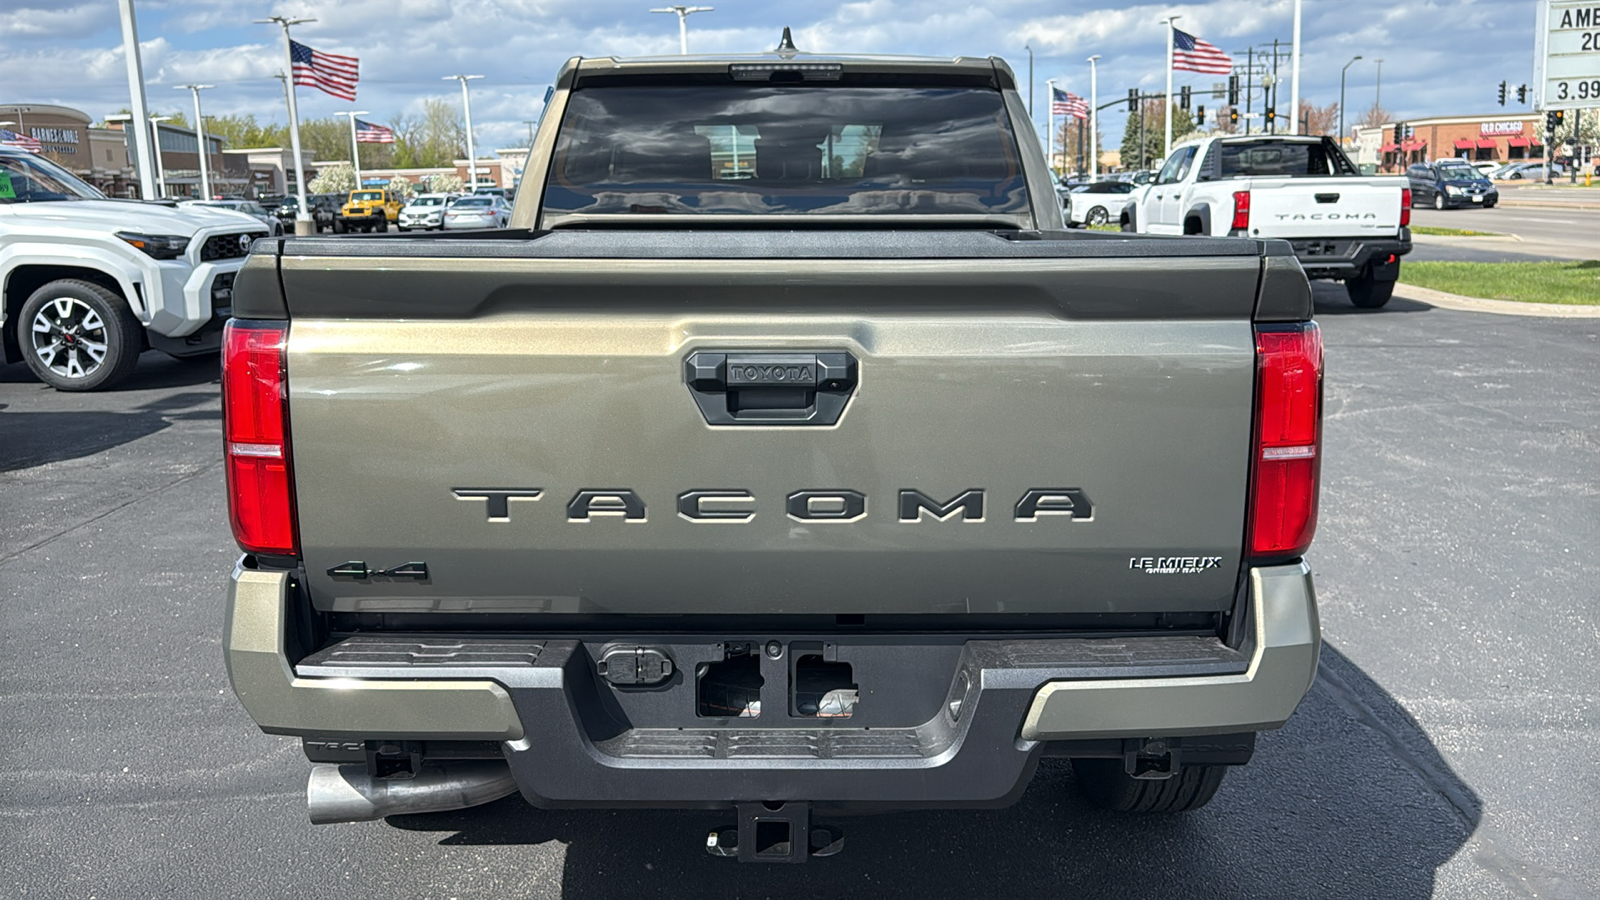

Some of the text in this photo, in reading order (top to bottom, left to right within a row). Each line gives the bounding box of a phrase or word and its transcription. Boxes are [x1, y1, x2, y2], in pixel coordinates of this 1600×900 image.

[1481, 122, 1494, 133] OLD
[730, 366, 813, 381] TOYOTA
[452, 487, 1095, 523] TACOMA
[1129, 556, 1222, 569] LE MIEUX
